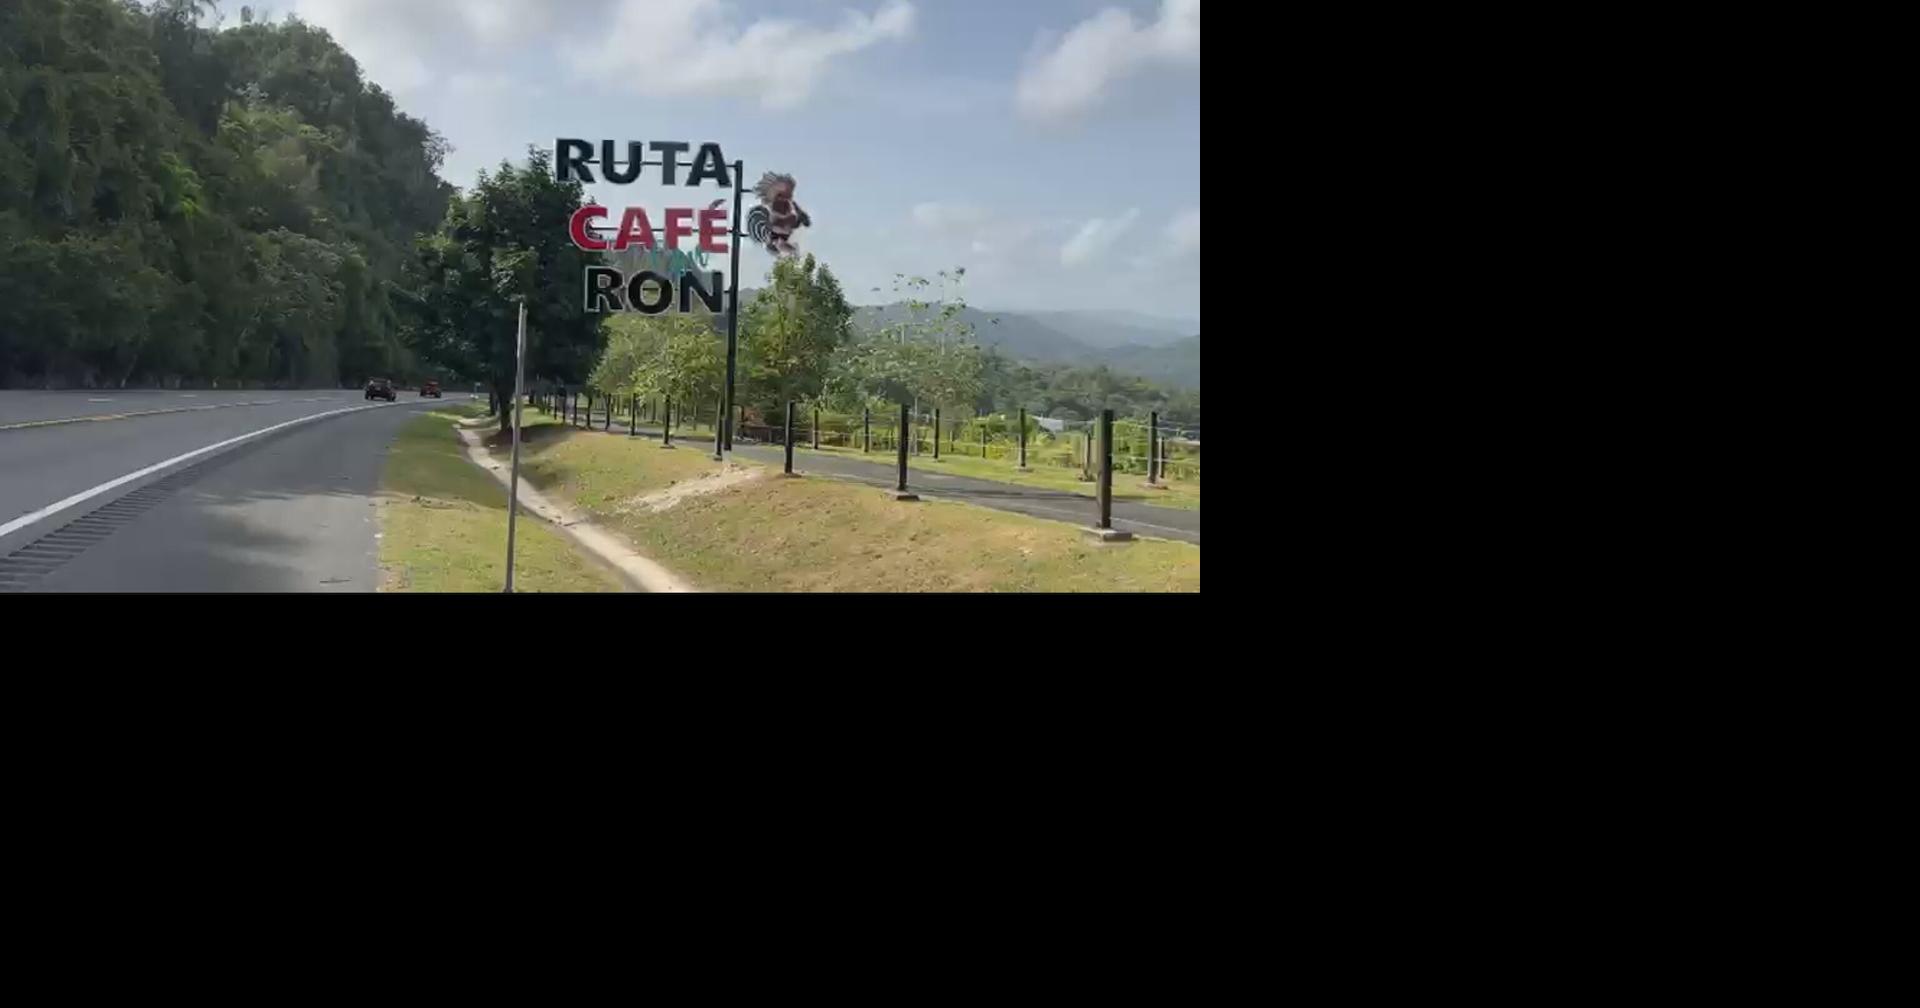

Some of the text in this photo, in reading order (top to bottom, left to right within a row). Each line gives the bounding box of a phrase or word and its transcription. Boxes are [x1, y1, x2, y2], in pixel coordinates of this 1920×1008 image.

[555, 138, 732, 187] RUTA
[569, 199, 730, 253] CAFÉ
[584, 266, 723, 314] RON
